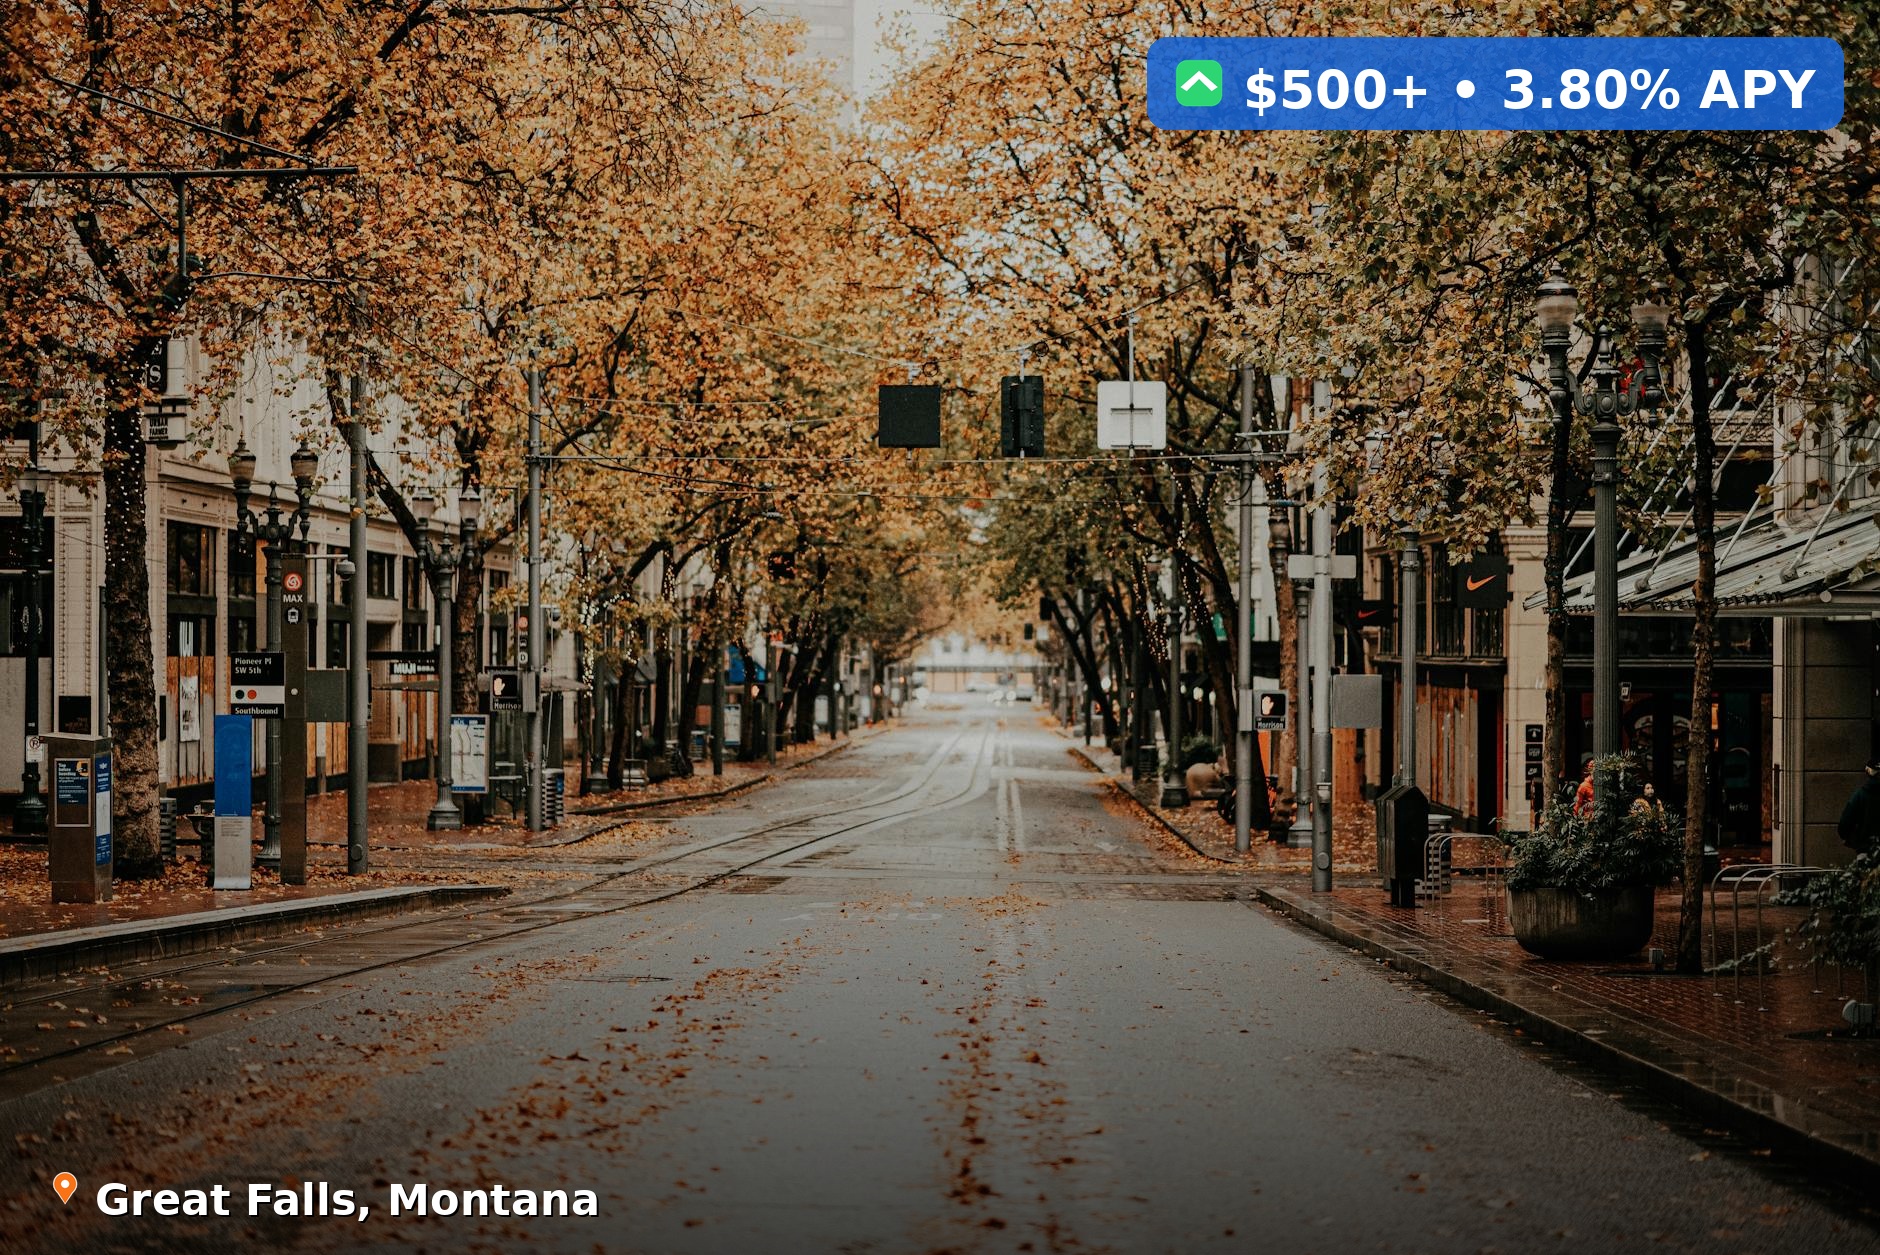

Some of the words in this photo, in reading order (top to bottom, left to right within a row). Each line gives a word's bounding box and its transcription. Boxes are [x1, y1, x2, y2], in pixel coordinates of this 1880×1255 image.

[283, 594, 303, 603] MAX
[234, 657, 262, 665] Pioneer
[234, 666, 247, 674] SW
[248, 666, 262, 674] 5th
[393, 662, 416, 674] MUJI
[234, 706, 279, 715] Southbound
[1257, 721, 1284, 729] Morrison
